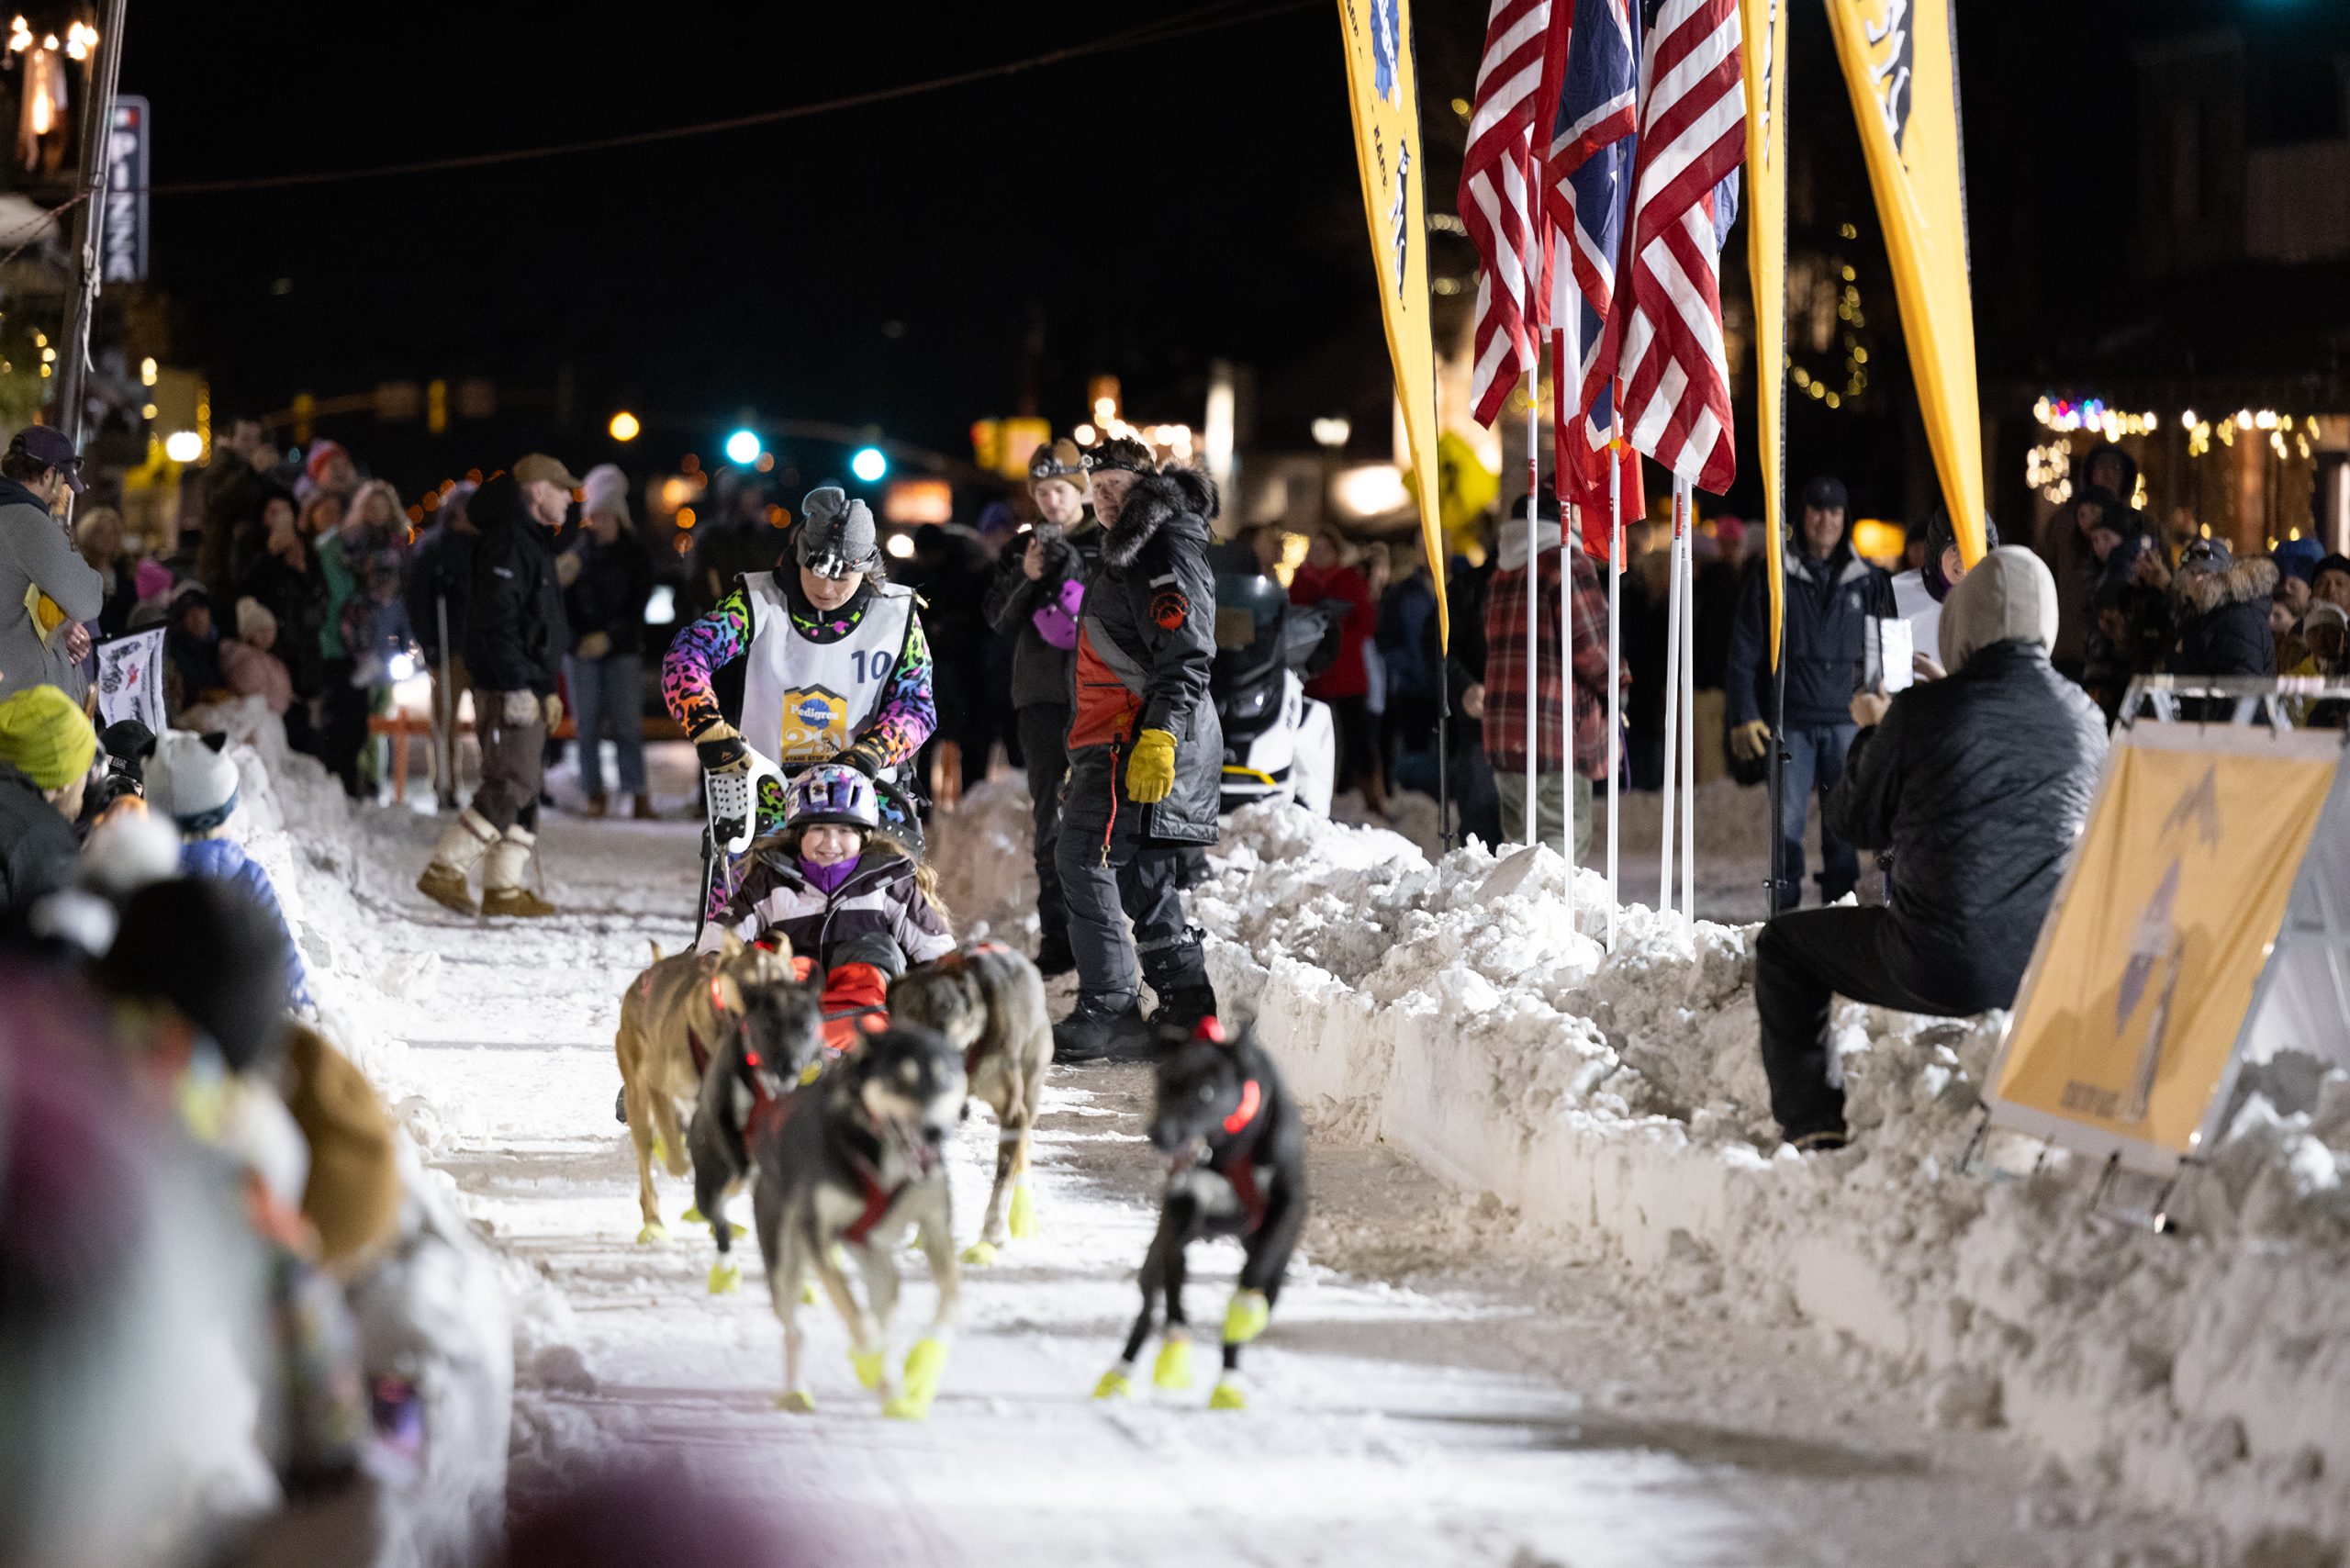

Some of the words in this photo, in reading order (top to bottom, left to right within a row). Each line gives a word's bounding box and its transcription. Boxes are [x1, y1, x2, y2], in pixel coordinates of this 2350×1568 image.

[106, 132, 137, 281] PIZZA
[851, 650, 892, 684] 10
[790, 704, 839, 721] Pedigree
